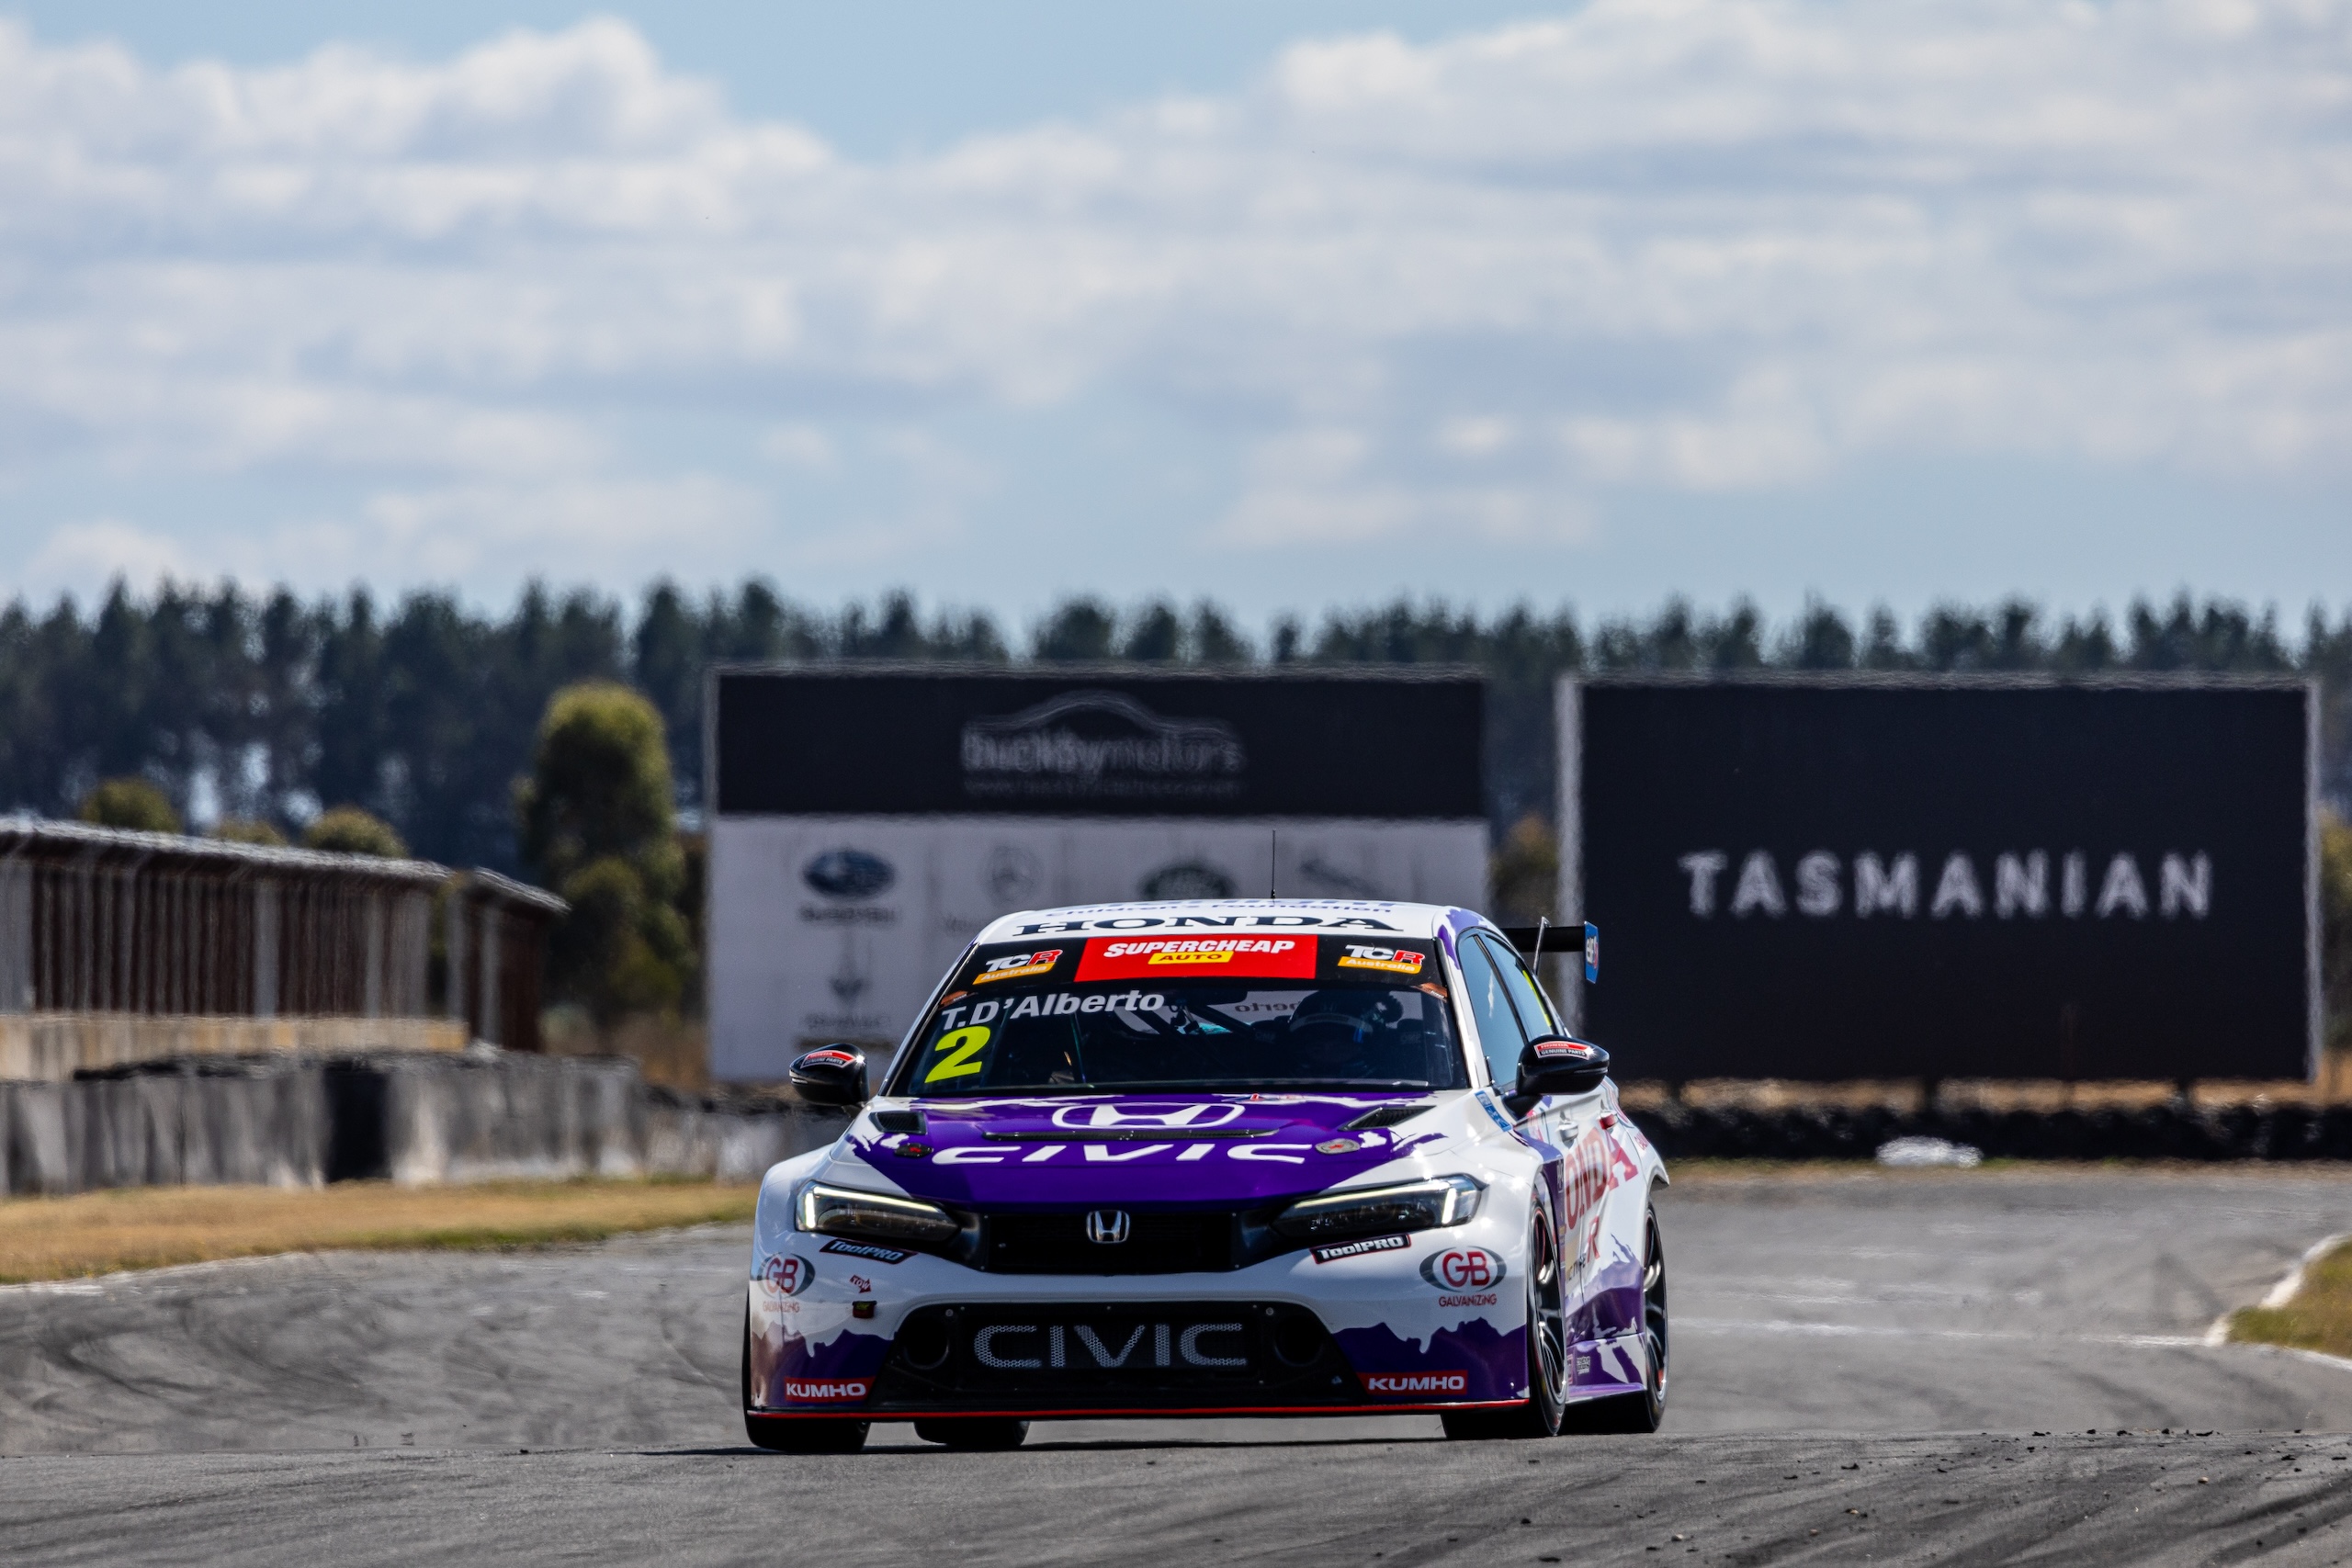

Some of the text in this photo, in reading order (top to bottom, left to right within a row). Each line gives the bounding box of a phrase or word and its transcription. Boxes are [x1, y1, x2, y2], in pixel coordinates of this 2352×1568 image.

[1678, 850, 2211, 919] TASMANIAN
[1012, 916, 1405, 936] HONDA
[1103, 940, 1295, 958] SUPERCHEAP
[1345, 944, 1426, 965] TCR
[985, 949, 1063, 973] TCR
[1345, 958, 1416, 972] Australia
[980, 964, 1048, 982] Australia
[924, 1025, 991, 1084] 2
[932, 1143, 1313, 1164] CIVIC
[830, 1239, 904, 1261] ToolPRO
[1317, 1235, 1405, 1259] ToolPRO
[765, 1257, 798, 1294] GB
[1442, 1250, 1491, 1288] GB
[852, 1276, 870, 1291] TOW
[974, 1324, 1248, 1368] CIVIC
[786, 1382, 866, 1397] KUMHO
[1368, 1375, 1464, 1391] KUMHO
